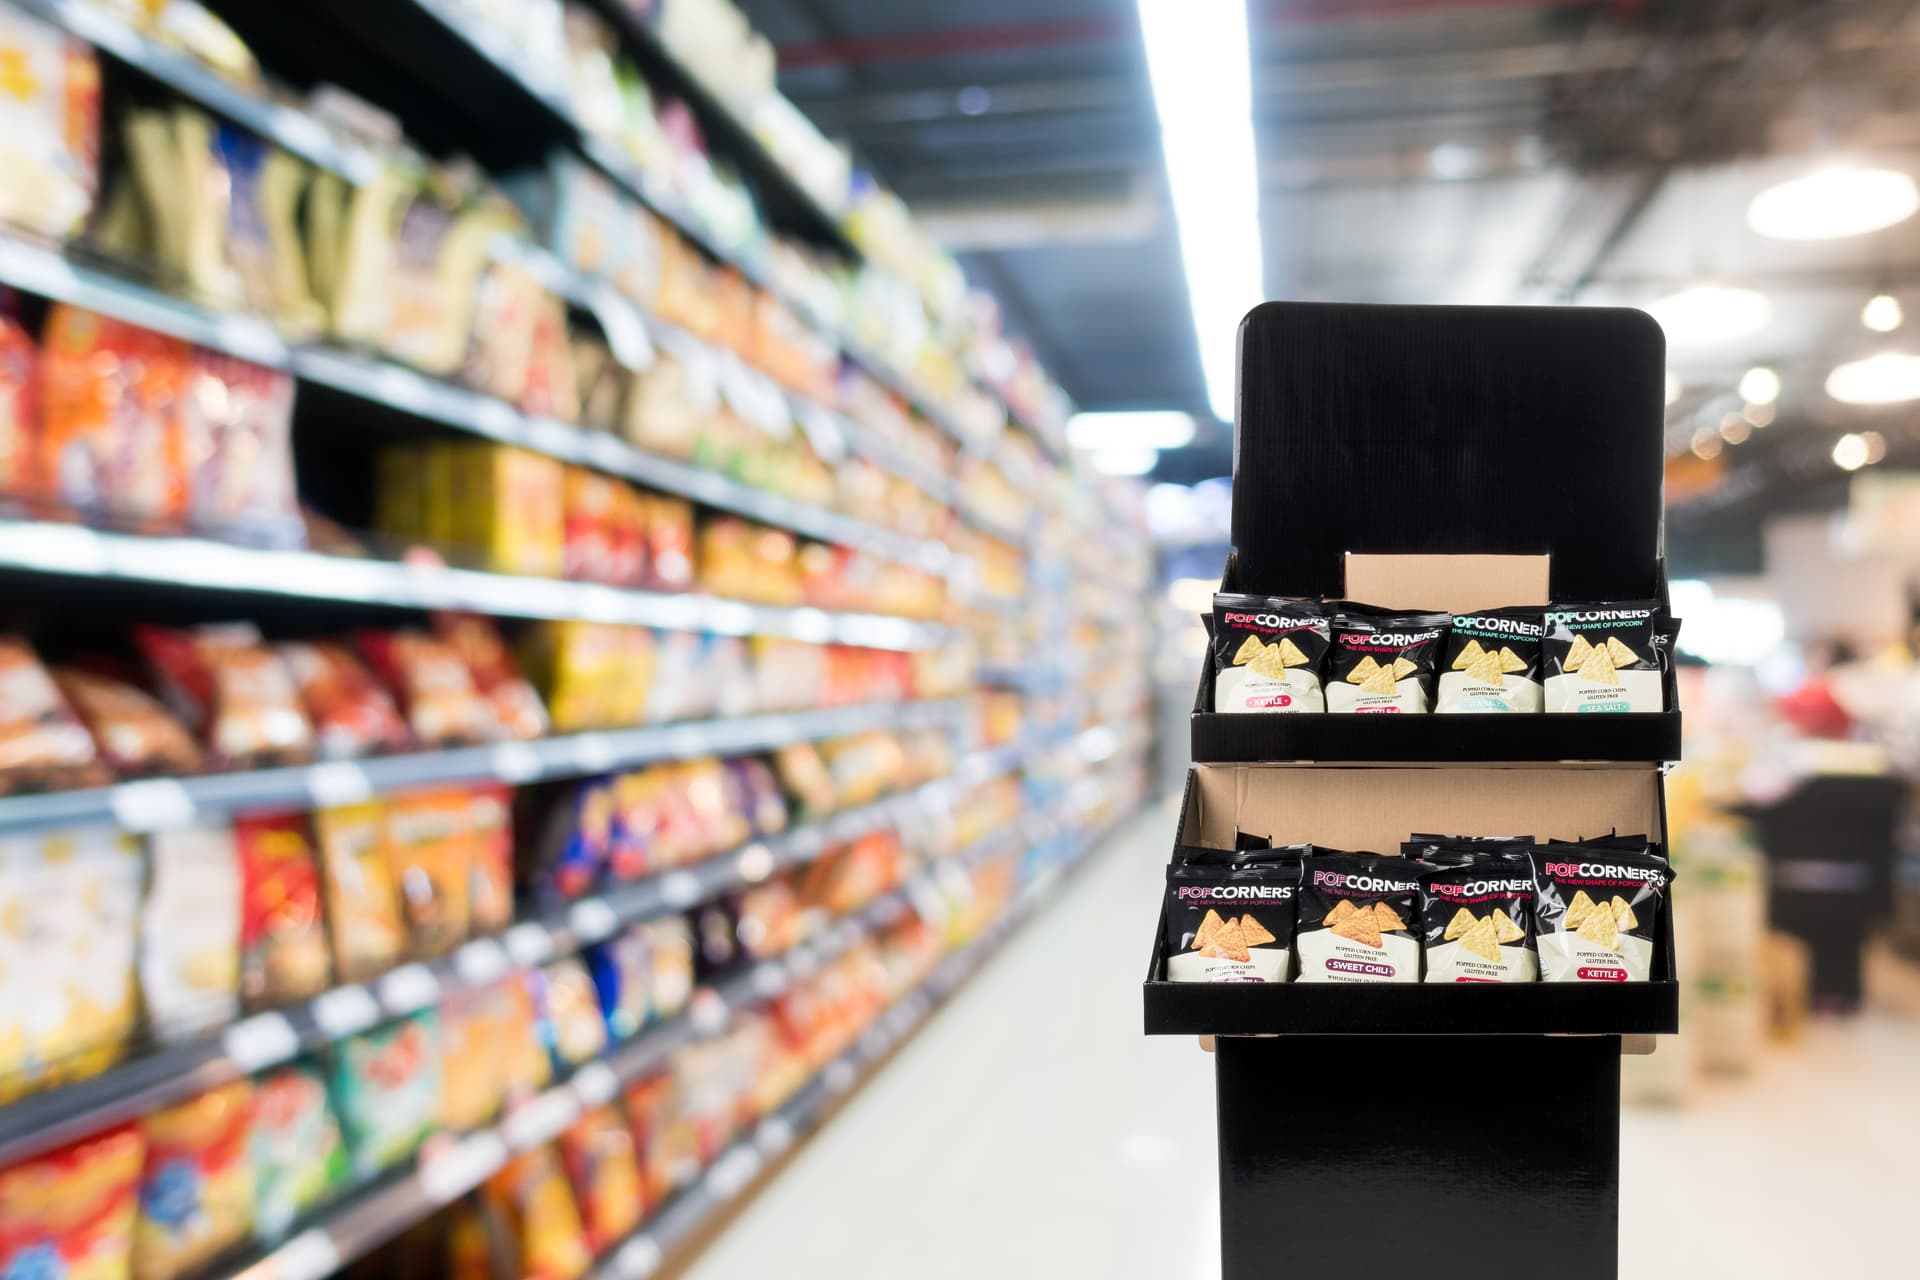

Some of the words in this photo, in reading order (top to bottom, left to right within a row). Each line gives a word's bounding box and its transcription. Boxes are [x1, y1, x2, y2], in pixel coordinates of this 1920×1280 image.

[1224, 612, 1327, 628] POPCORNERS
[1544, 609, 1650, 625] POPCORNERS
[1582, 622, 1602, 630] SHAPE
[1612, 620, 1643, 628] POPCORN
[1340, 629, 1440, 646] POPCORNERS
[1479, 630, 1498, 638] SHAPE
[1509, 634, 1539, 642] POPCORN
[1587, 704, 1602, 712] SEA
[1603, 703, 1621, 711] SALT
[1546, 863, 1659, 881] POPCORNERS
[1179, 886, 1293, 899] POPCORNERS
[1343, 952, 1365, 960] GLUTEN
[1333, 961, 1364, 972] SWEET
[1365, 965, 1388, 974] CHILI
[1587, 969, 1618, 978] KETTLE
